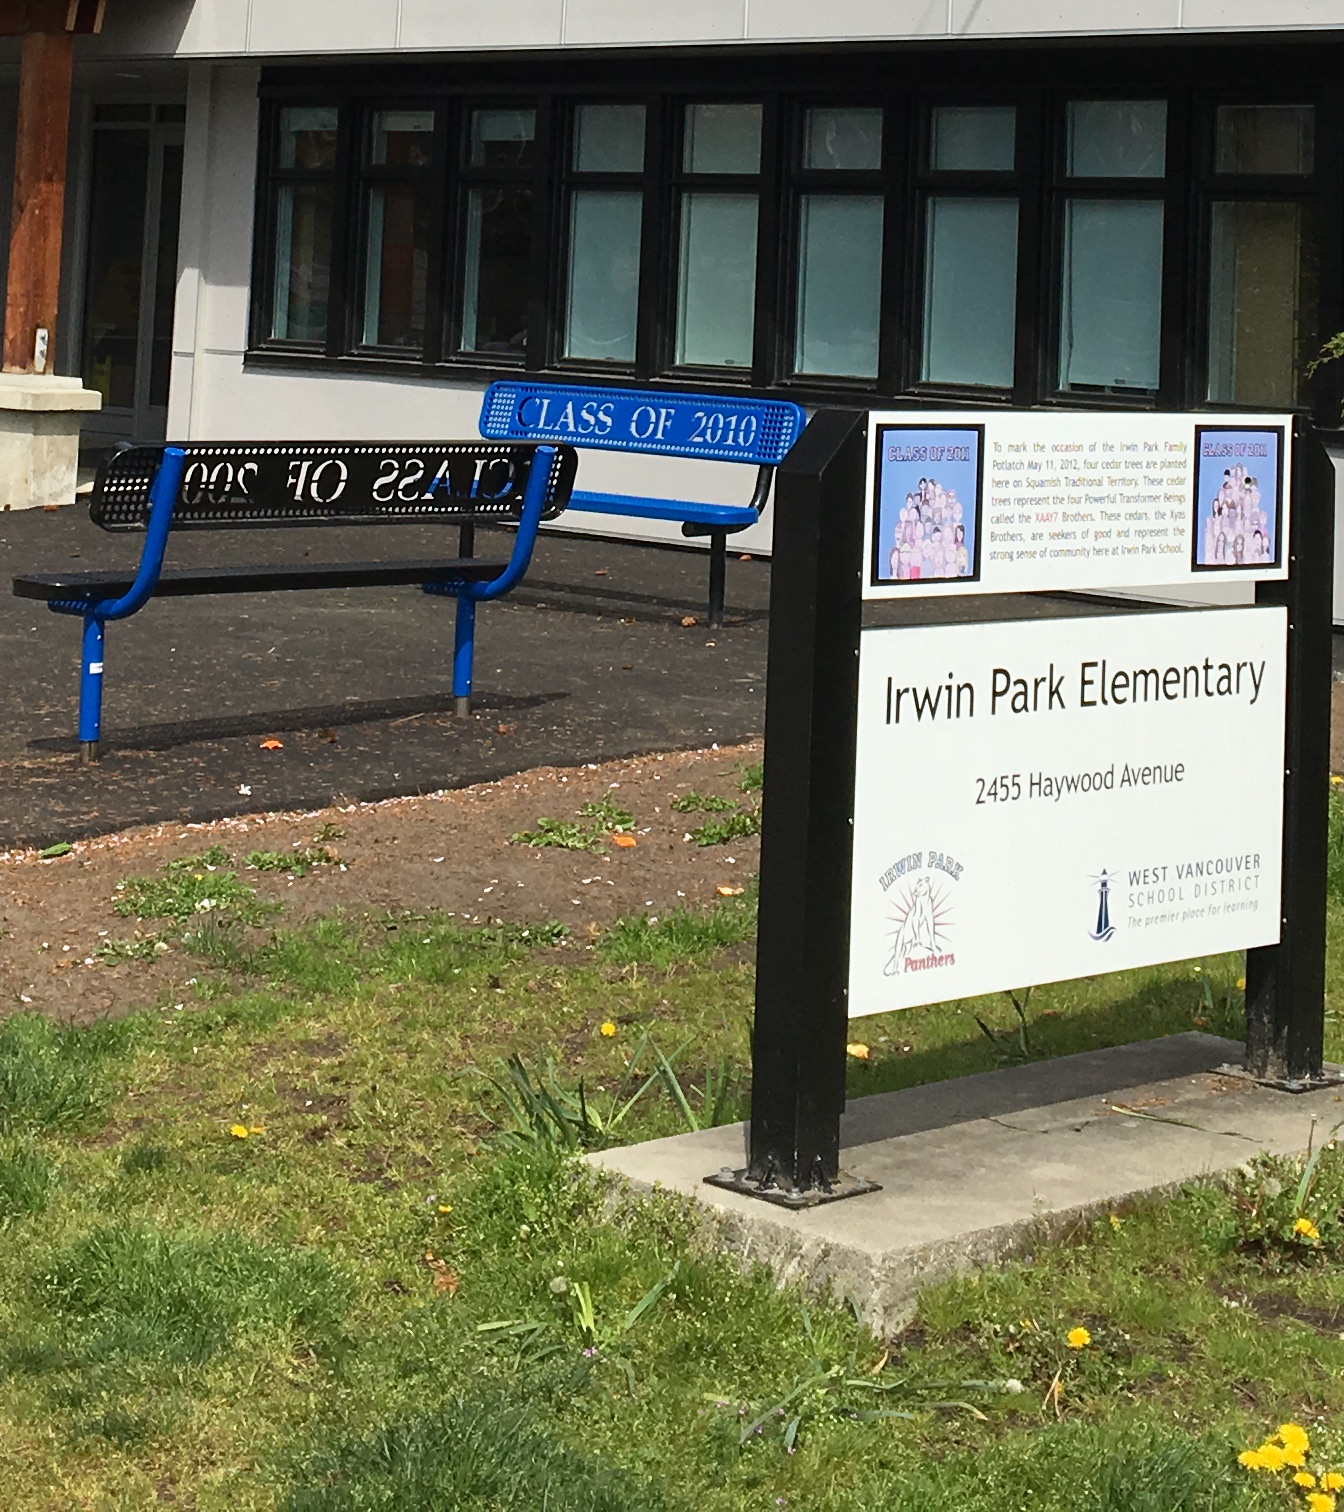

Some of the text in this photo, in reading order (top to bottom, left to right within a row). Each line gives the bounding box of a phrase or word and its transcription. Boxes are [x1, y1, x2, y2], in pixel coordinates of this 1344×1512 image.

[516, 395, 757, 447] CLASS OF 2010
[888, 445, 928, 462] CLASS
[929, 445, 945, 462] OF
[993, 441, 1188, 454] To mark the occasion of the Irwin Park Family
[1203, 443, 1233, 457] CLASS
[1234, 443, 1247, 457] OF
[992, 458, 1186, 472] Potlatch May 11, 2012, four cedar trees are planted
[992, 476, 1186, 490] here on Squamish Traditional Territory. These cedar
[991, 492, 1186, 508] trees represent the four Powerful Transformer Beings
[990, 514, 1014, 524] called
[1018, 514, 1032, 524] the
[1062, 511, 1096, 522] Brothers.
[1100, 510, 1121, 521] These
[1124, 510, 1150, 522] cedars,
[1154, 510, 1166, 520] the
[990, 526, 1185, 543] Brothers, are seekers of good and represent the
[989, 543, 1184, 562] strong sense of community here at Irwin Park School.
[885, 657, 1267, 725] Irwin Park Elementary
[974, 759, 1185, 805] 2455 Haywood Avenue
[878, 851, 964, 892] IRWIN PARK
[1128, 853, 1261, 887] WEST VANCOUVER
[1128, 875, 1260, 908] SCHOOL DISTRICT
[1128, 899, 1259, 928] The premier place for learning
[903, 953, 955, 973] Panthers
